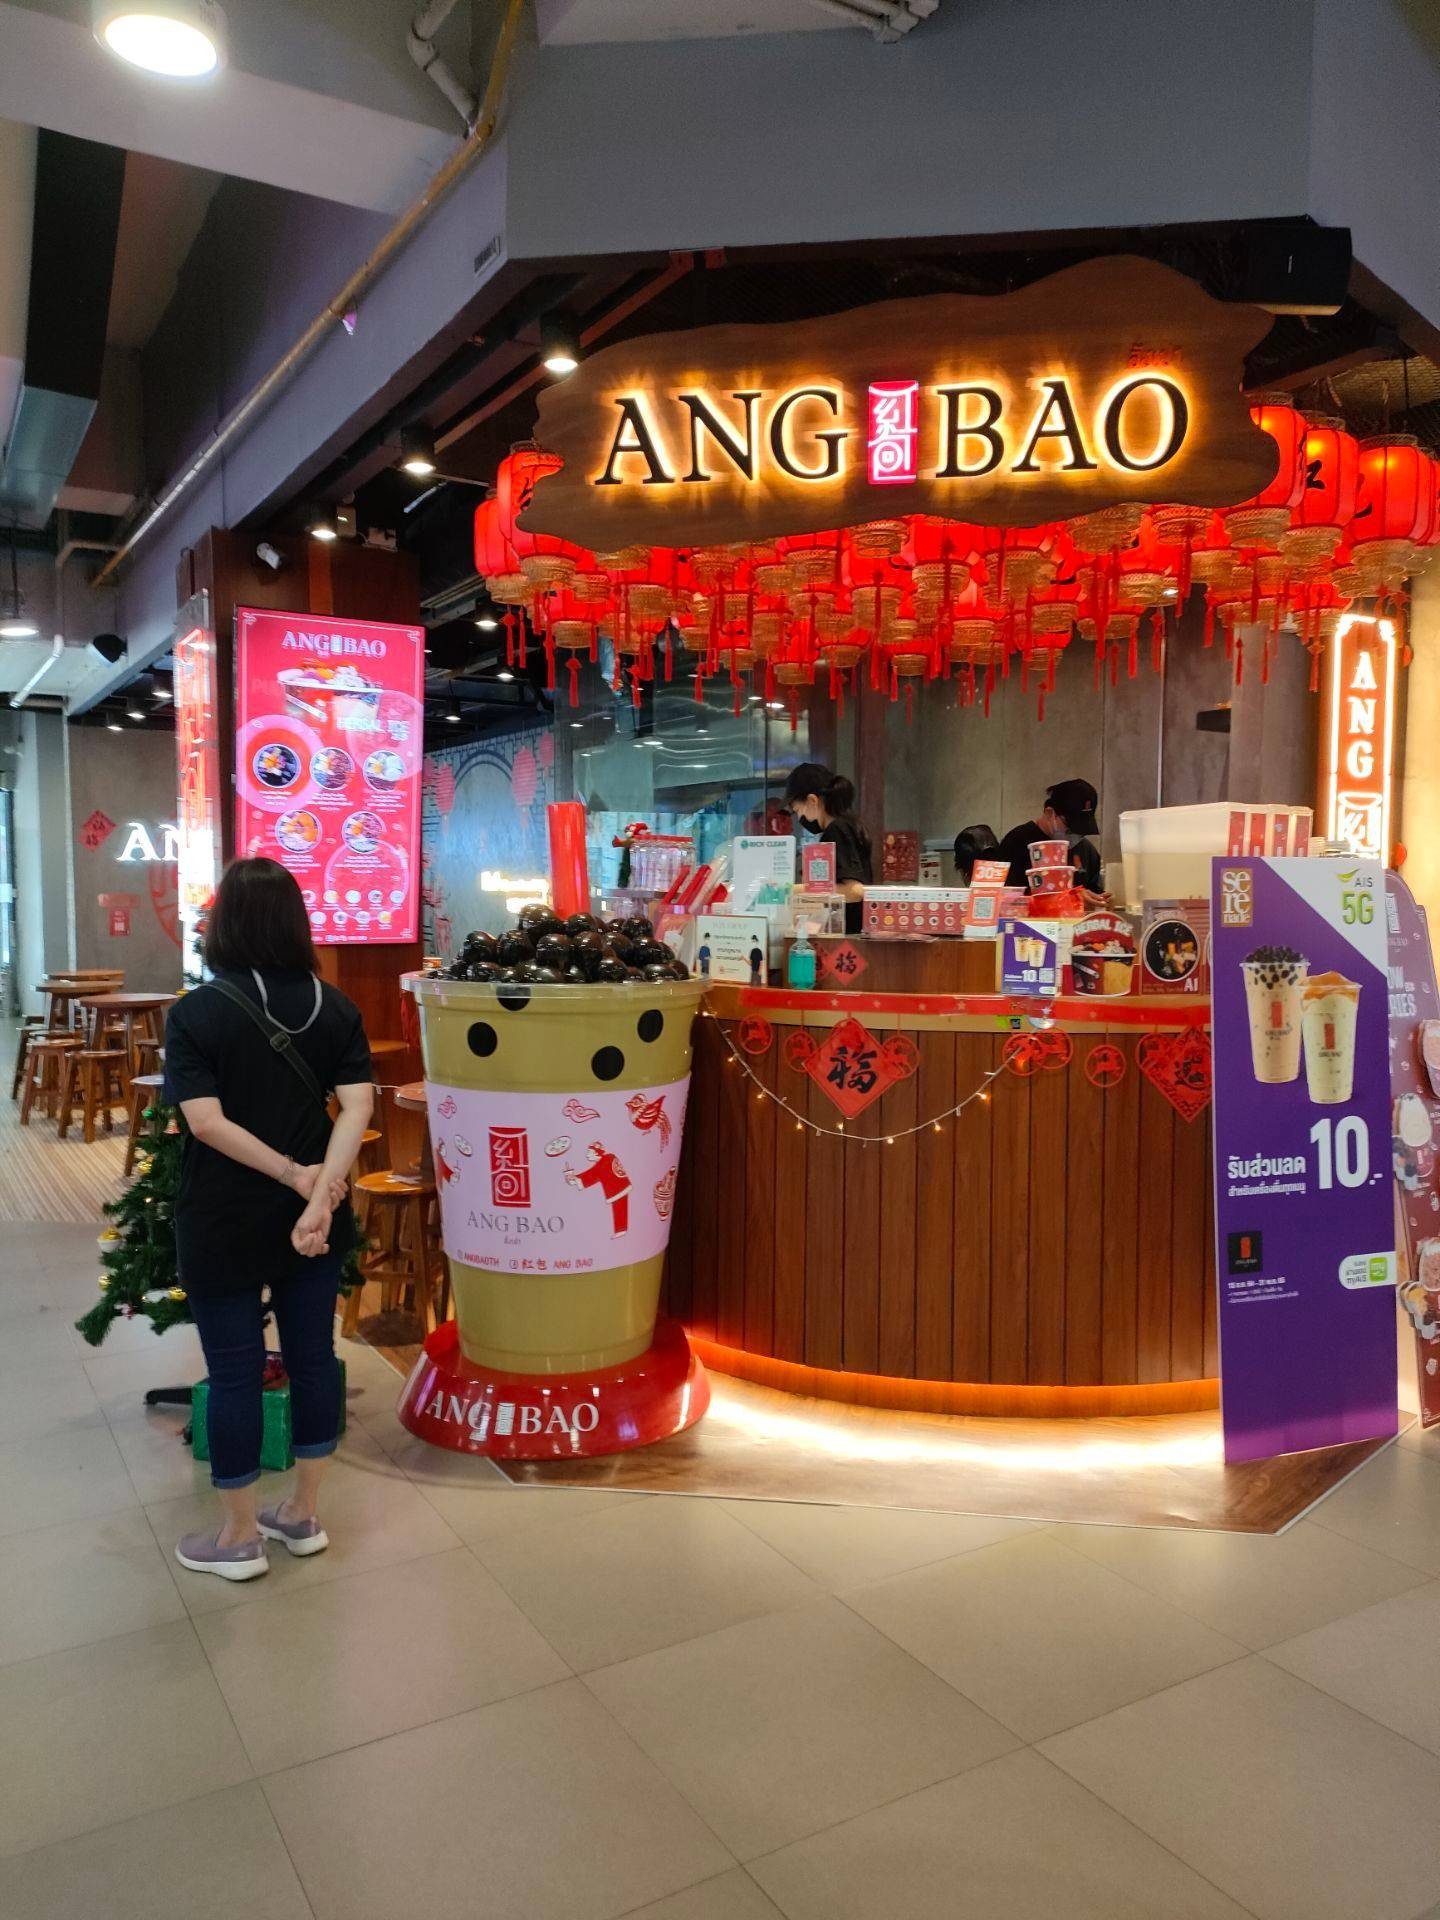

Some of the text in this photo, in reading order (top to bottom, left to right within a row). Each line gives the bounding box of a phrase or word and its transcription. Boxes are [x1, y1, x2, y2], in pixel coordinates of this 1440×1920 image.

[595, 377, 1189, 485] ANG BAO
[281, 630, 331, 656] ANG
[342, 637, 387, 659] BAO
[1346, 651, 1379, 779] ANG
[1222, 871, 1252, 893] se
[1354, 876, 1374, 888] AIS
[1342, 890, 1374, 926] 5G
[826, 1042, 878, 1094] 福
[1227, 1152, 1307, 1180] รับส่วนลด
[467, 1210, 565, 1234] ANG BAO
[553, 1257, 593, 1269] ANG BAO
[425, 1390, 491, 1430] ANG
[518, 1402, 600, 1435] BAO
